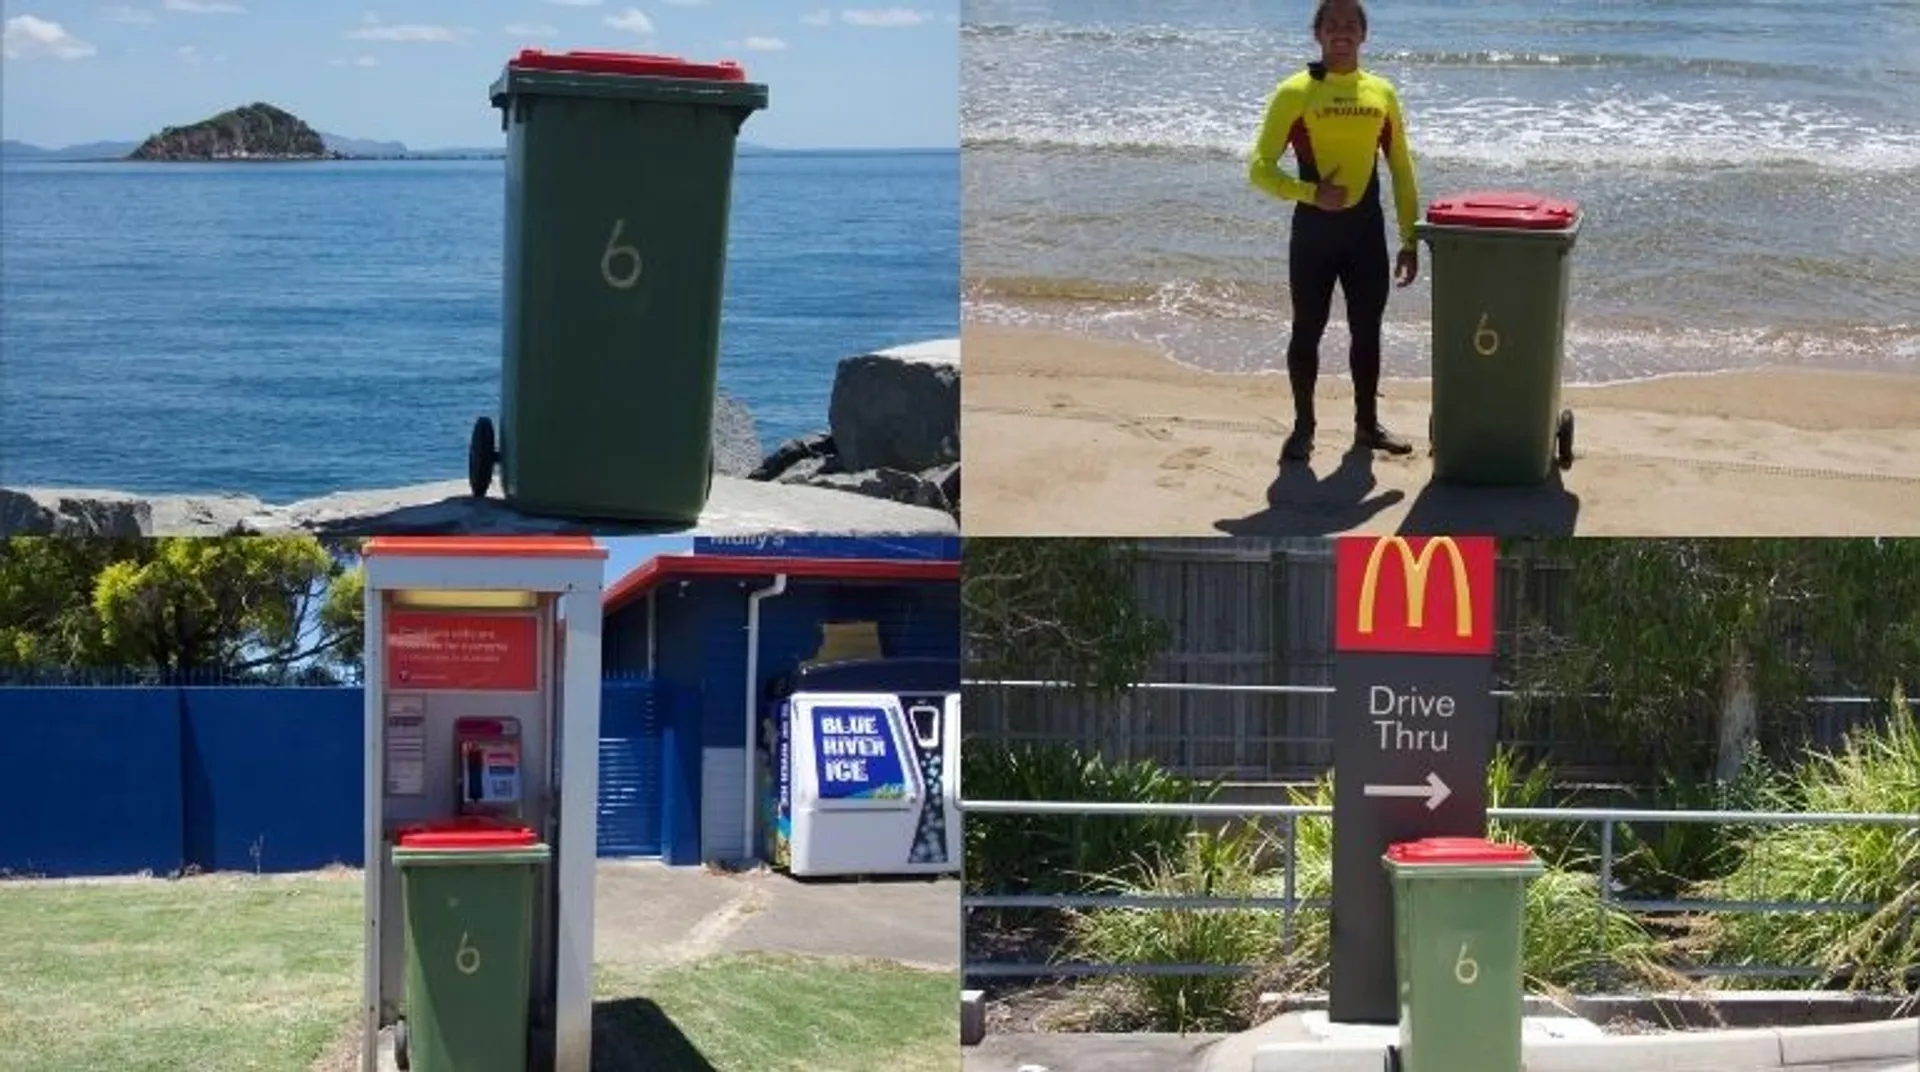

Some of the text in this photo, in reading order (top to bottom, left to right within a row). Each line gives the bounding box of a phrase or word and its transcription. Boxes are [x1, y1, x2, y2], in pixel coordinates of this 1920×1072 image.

[601, 218, 643, 290] 6
[1474, 311, 1499, 356] 6
[1369, 685, 1456, 718] Drive
[821, 714, 879, 735] BLUE
[1373, 720, 1449, 752] Thru
[822, 735, 887, 757] RIVER
[825, 757, 870, 782] ICE
[456, 931, 481, 975] 6
[1455, 941, 1479, 985] 6
